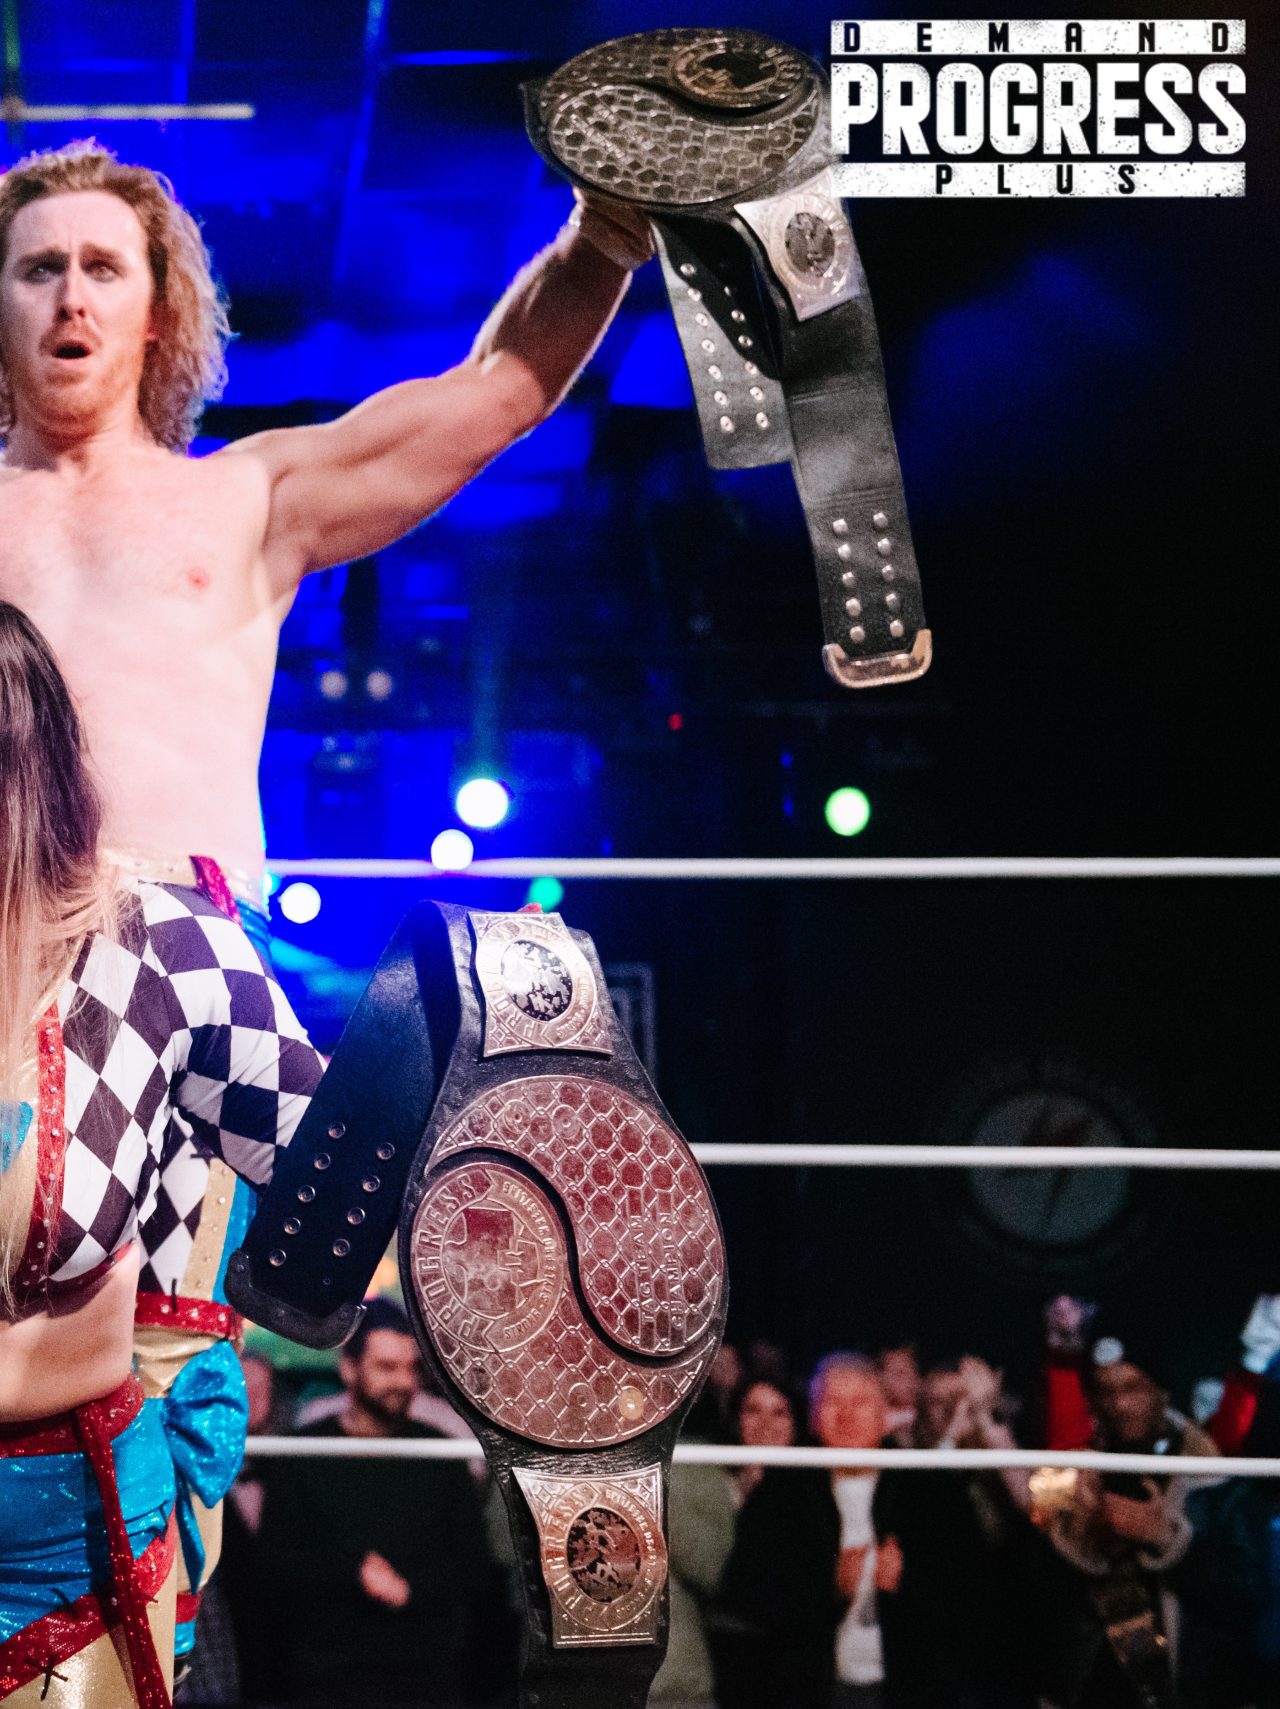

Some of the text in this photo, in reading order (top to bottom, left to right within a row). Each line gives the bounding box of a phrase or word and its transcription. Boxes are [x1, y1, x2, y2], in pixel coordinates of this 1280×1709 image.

[417, 1173, 478, 1339] PROGRESS
[640, 1281, 655, 1325] TAG
[659, 1212, 685, 1330] CHAMPION
